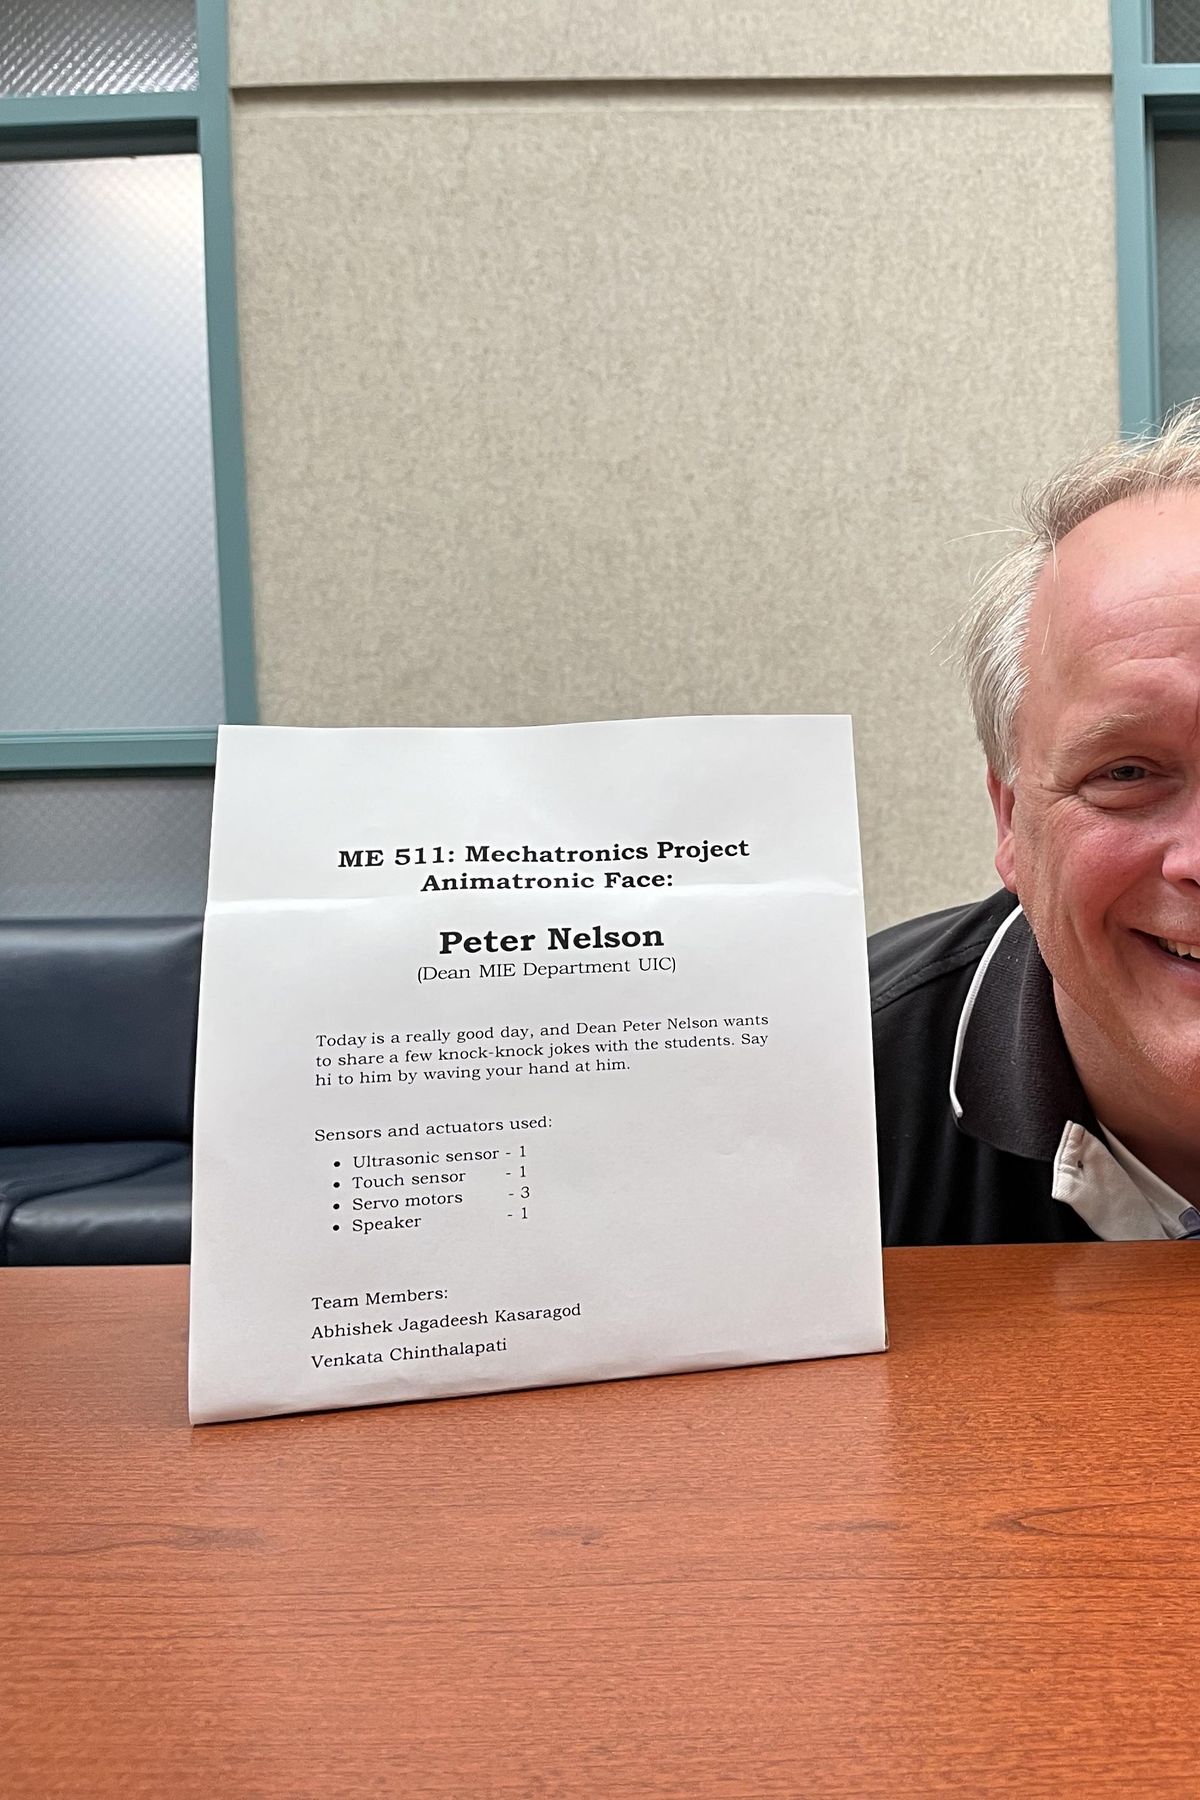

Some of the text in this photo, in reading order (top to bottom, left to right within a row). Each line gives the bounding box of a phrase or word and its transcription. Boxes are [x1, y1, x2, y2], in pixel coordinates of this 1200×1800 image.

[337, 839, 751, 868] ME 511: Mechatronics Project
[419, 871, 673, 893] Animatronic Face:
[438, 924, 665, 955] Peter Nelson
[417, 956, 676, 985] (Dean MIE Department UIC)
[315, 1015, 769, 1049] Today is a really good day, and Dean Peter Nelson wants
[315, 1032, 769, 1068] to share a few knock-knock jokes with the students. Say
[315, 1058, 630, 1087] hi to him by waving your hand at him.
[314, 1115, 552, 1142] Sensors and actuators used:
[352, 1151, 440, 1169] Ultrasonic
[445, 1149, 500, 1163] sensor
[519, 1145, 526, 1158] 1
[351, 1173, 405, 1190] Touch
[411, 1172, 467, 1186] sensor
[519, 1165, 527, 1178] 1
[352, 1197, 400, 1211] Servo
[404, 1193, 463, 1207] motors
[520, 1185, 530, 1199] 3
[352, 1215, 422, 1235] Speaker
[521, 1206, 528, 1220] 1
[310, 1288, 448, 1311] Team Members:
[310, 1302, 582, 1340] Abhishek Jagadeesh Kasaragod
[310, 1337, 508, 1369] Venkata Chinthalapati
